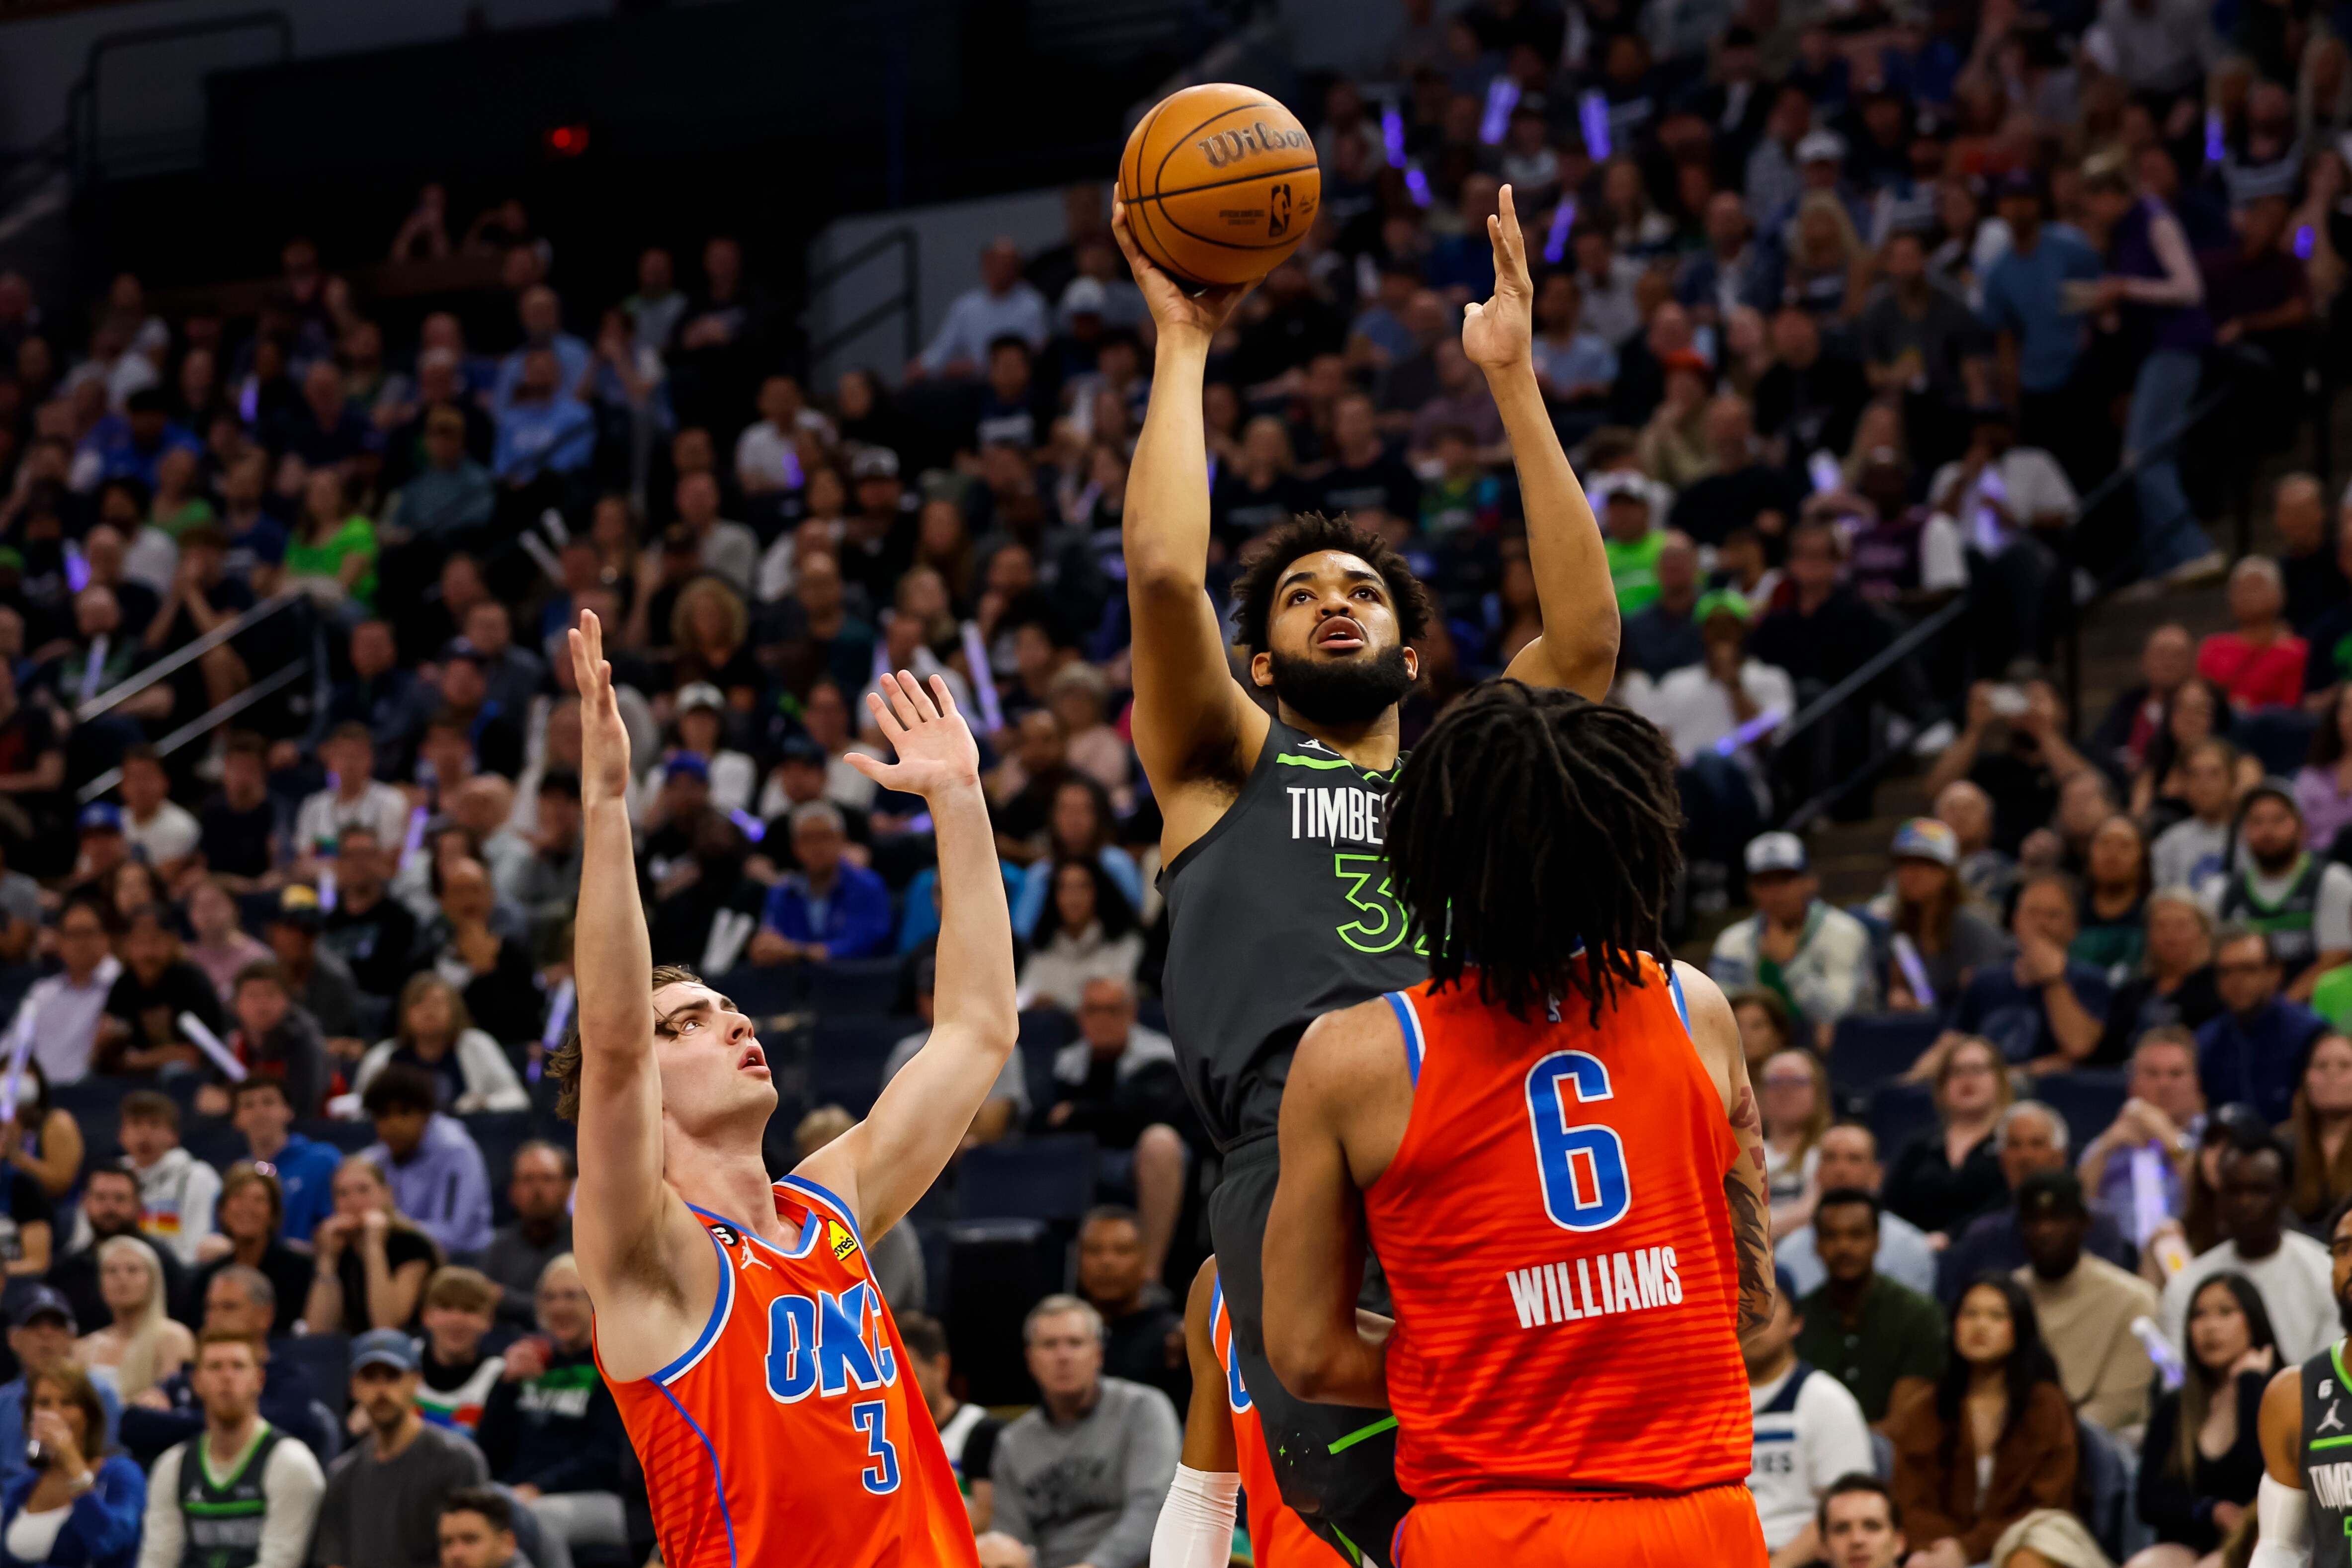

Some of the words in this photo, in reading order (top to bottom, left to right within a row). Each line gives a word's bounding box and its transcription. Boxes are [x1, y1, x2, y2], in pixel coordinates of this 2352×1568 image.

[1196, 121, 1313, 169] Wilson
[1286, 787, 1402, 848] TIMBE
[1524, 1049, 1632, 1233] 6
[1506, 1246, 1683, 1329] WILLIAMS
[764, 1279, 898, 1404] OKC
[851, 1399, 901, 1495] 3
